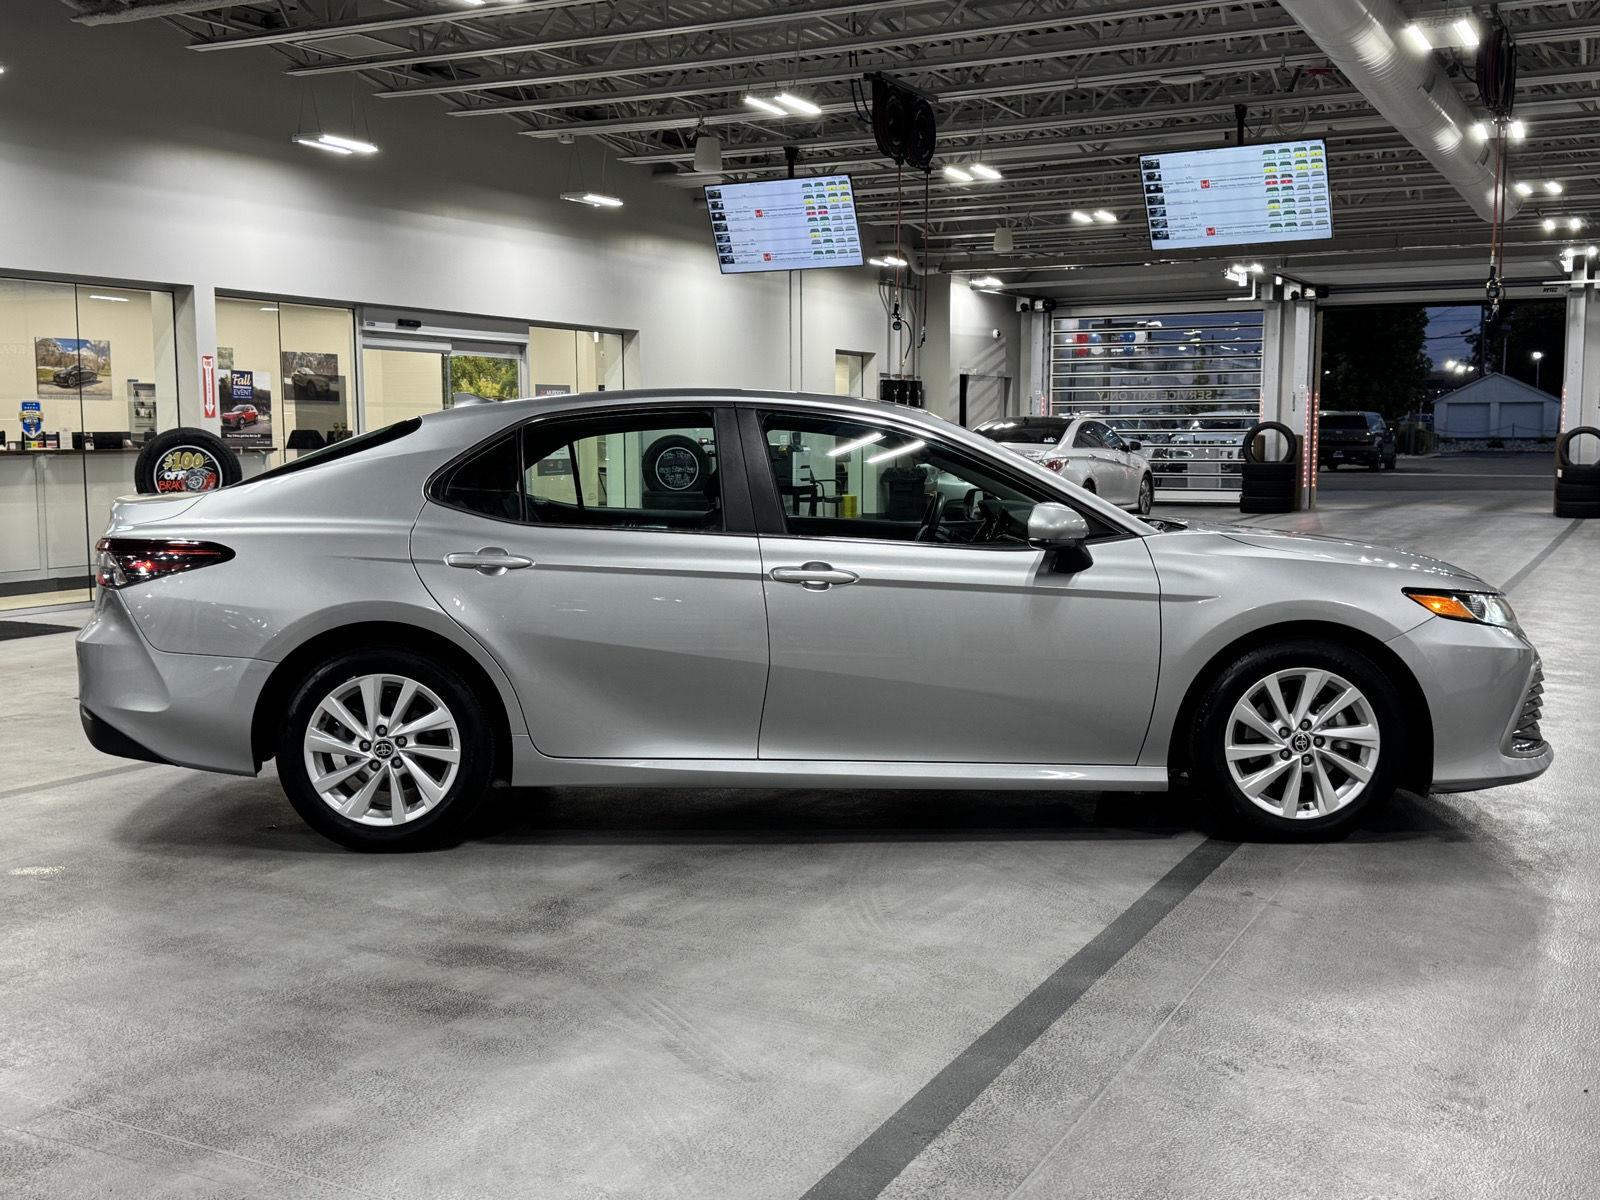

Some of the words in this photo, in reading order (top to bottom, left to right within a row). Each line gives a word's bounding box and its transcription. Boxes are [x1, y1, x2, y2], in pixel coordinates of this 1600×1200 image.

[232, 373, 252, 385] Fall
[162, 451, 204, 471] $100
[164, 470, 187, 480] OFF
[158, 479, 184, 490] BRAK
